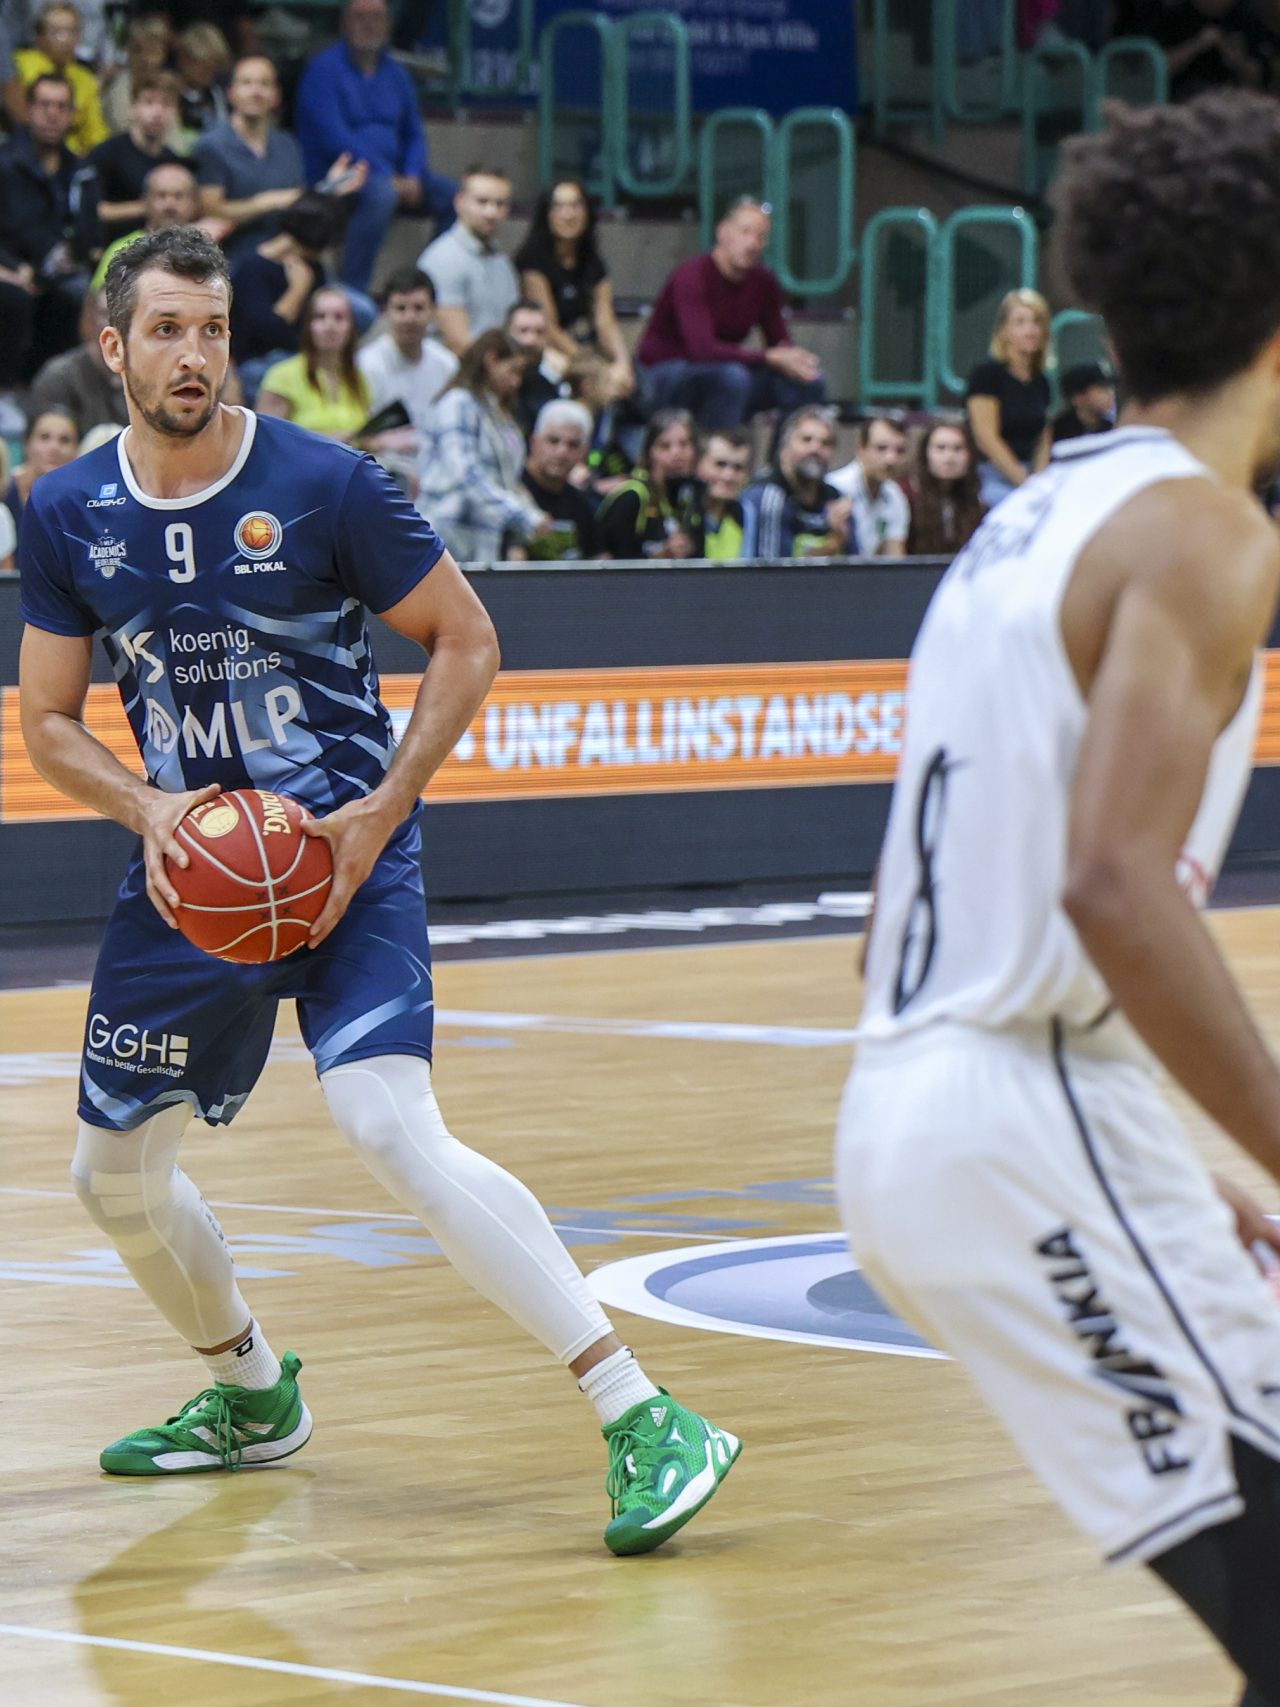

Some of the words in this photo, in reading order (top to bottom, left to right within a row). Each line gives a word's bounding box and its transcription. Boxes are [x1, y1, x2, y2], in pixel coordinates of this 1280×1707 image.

[89, 542, 127, 559] ACADEMICS
[164, 522, 197, 584] 9
[234, 564, 253, 575] BBL
[253, 561, 287, 573] POKAL
[174, 651, 281, 684] solutions
[182, 685, 302, 759] MLP
[484, 691, 903, 771] UNFALLINSTANDSE
[89, 1013, 168, 1063] GGH
[106, 1056, 114, 1066] in
[114, 1058, 137, 1073] bester
